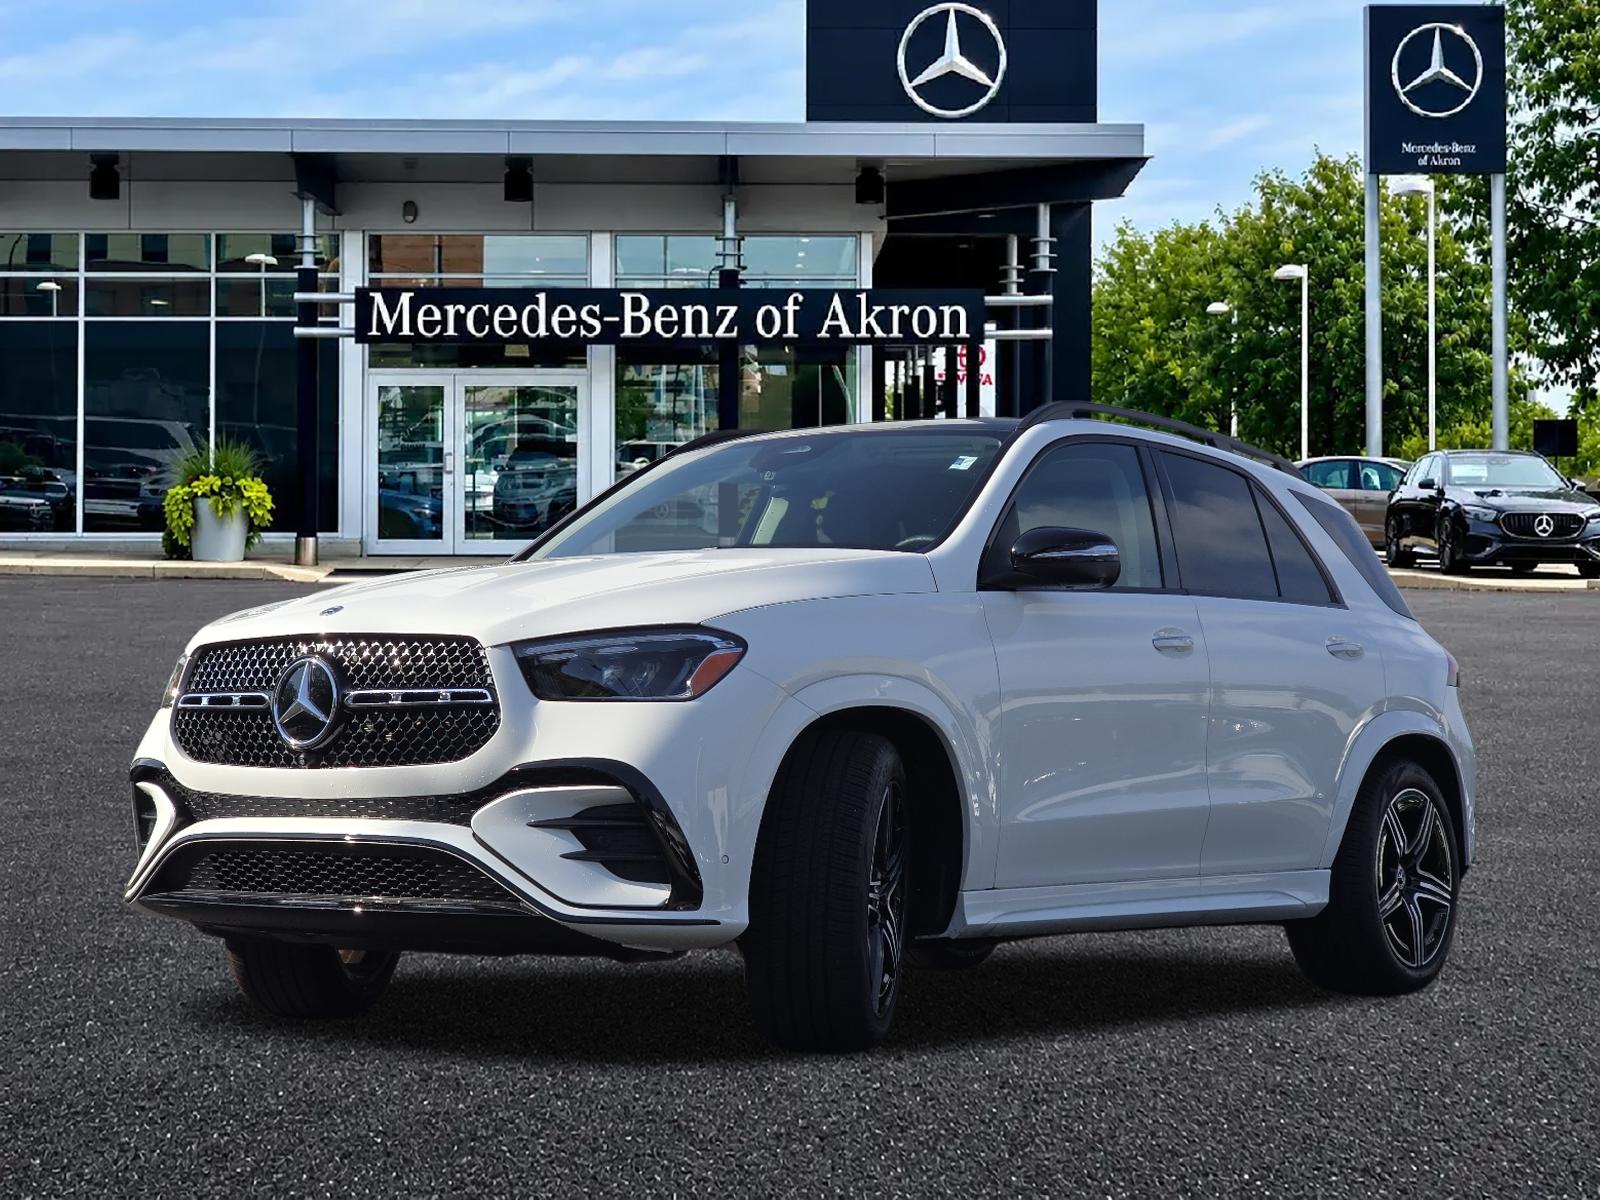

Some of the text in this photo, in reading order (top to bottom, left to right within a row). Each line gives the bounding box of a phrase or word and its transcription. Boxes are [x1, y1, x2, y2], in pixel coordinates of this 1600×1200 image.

[1401, 141, 1477, 154] Mercedes-Benz
[1417, 154, 1461, 166] of Akron
[367, 291, 971, 339] Mercedes-Benz of Akron
